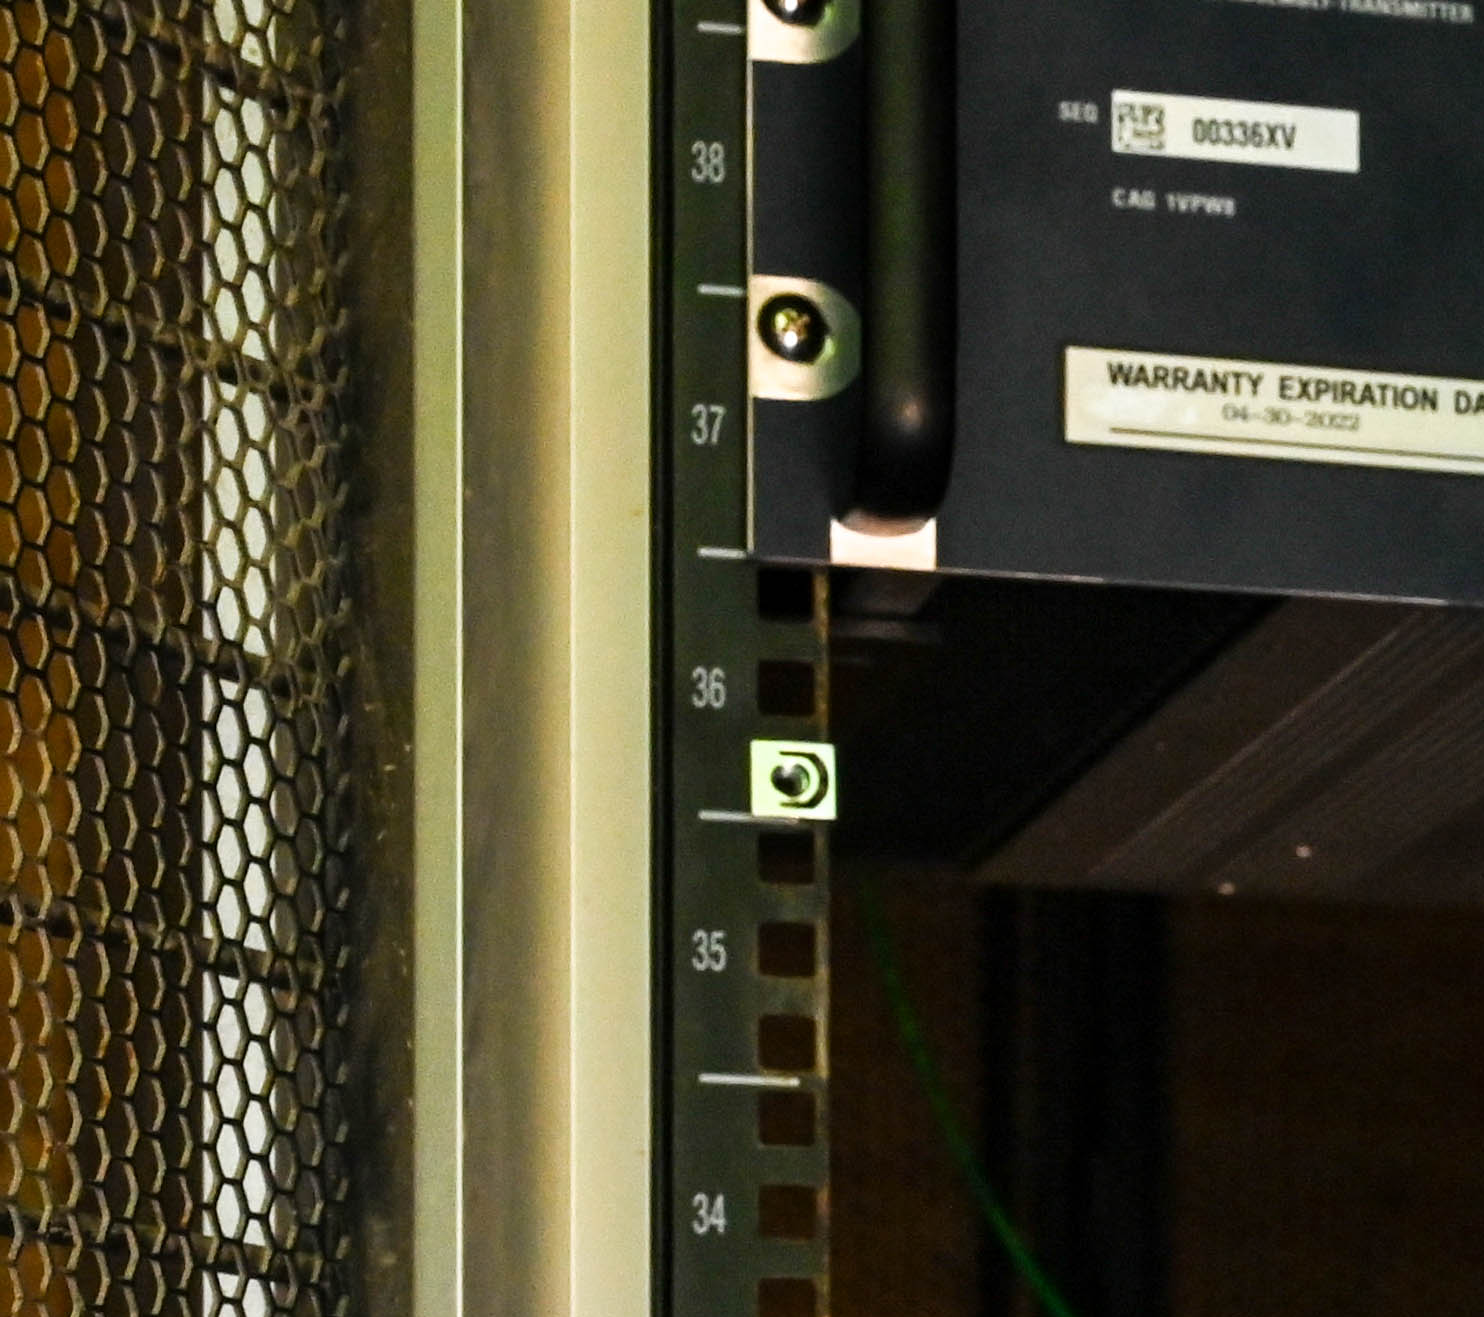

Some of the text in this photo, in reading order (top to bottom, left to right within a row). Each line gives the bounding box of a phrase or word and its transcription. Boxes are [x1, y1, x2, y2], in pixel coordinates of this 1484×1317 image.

[1192, 119, 1297, 150] 00336XV
[692, 141, 726, 183] 38
[1107, 361, 1264, 398] WARRANTY
[1278, 374, 1439, 412] EXPIRATION
[692, 404, 726, 445] 37
[692, 666, 726, 708] 36
[692, 930, 727, 972] 35
[692, 1193, 727, 1235] 34
